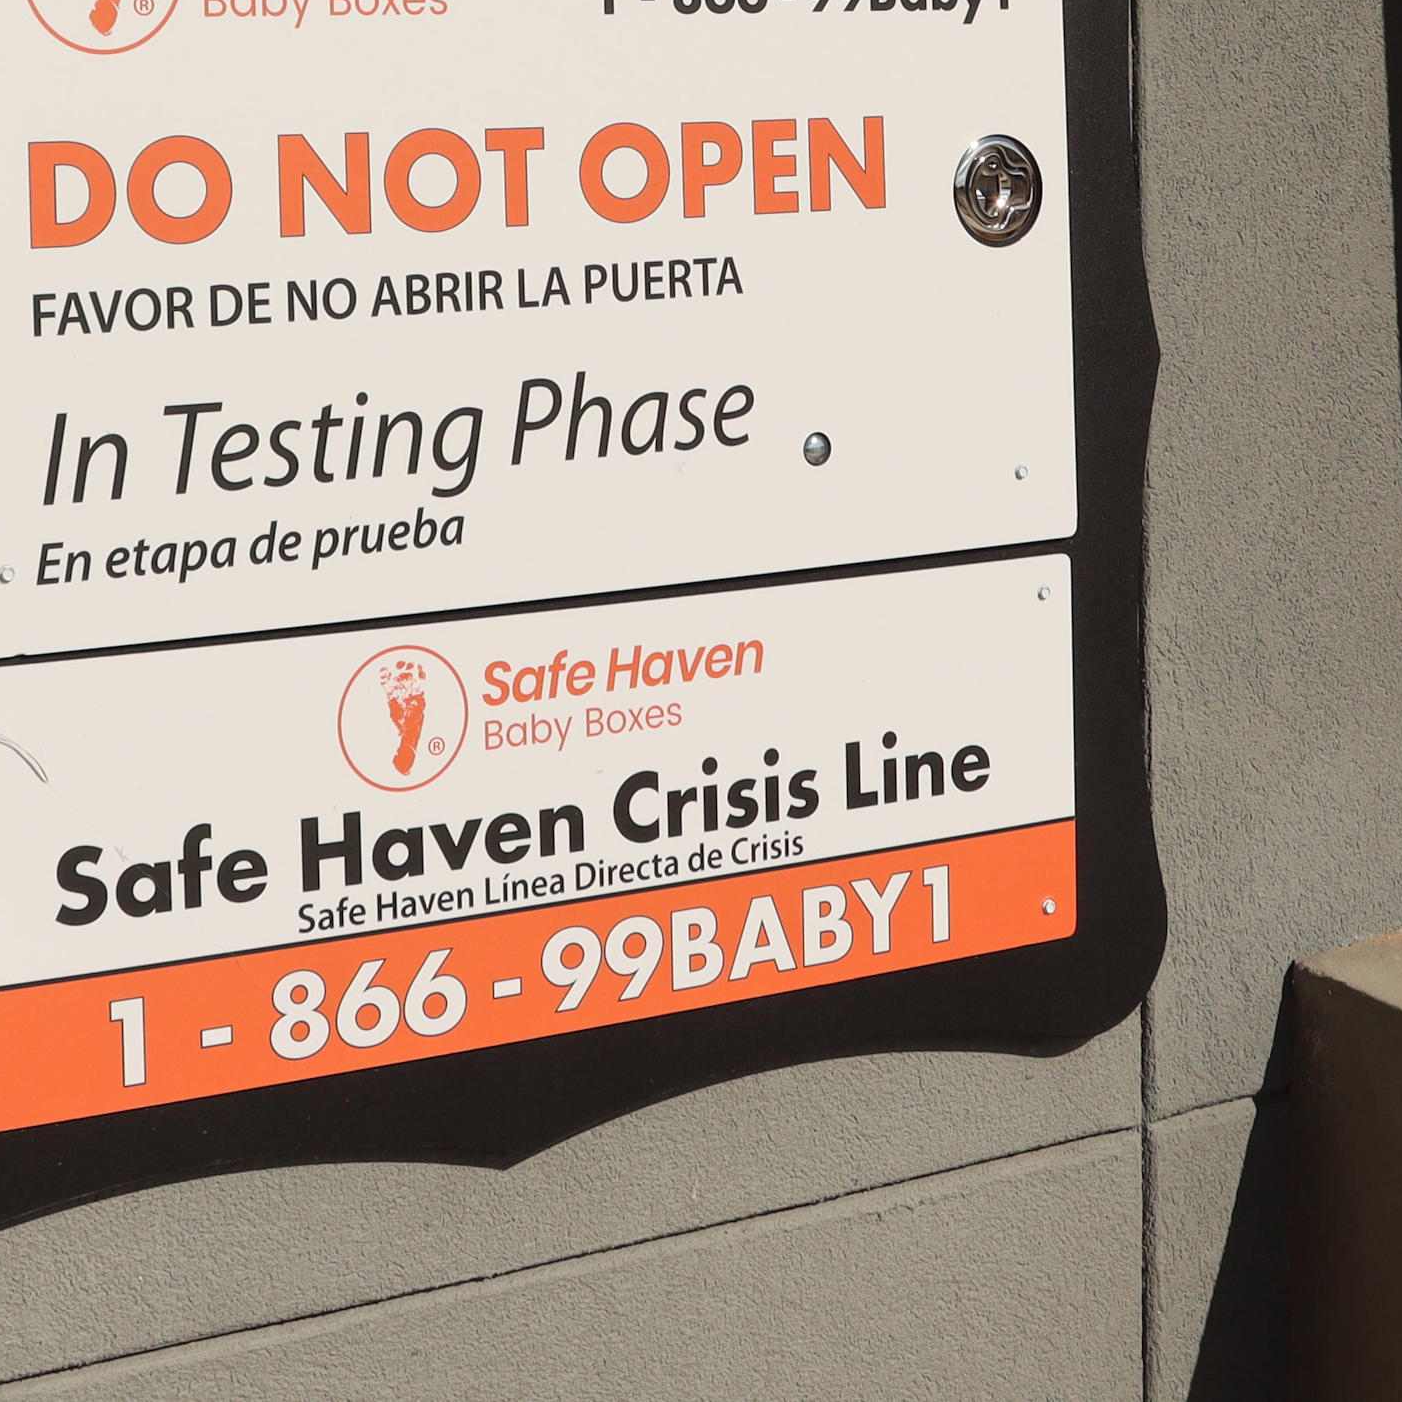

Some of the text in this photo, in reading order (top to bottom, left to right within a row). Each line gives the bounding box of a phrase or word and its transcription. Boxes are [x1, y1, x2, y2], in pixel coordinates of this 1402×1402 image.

[27, 115, 887, 250] DO NOT OPEN
[32, 256, 744, 337] FAVOR DE NO ABRIR LA PUERTA
[43, 370, 755, 506] In Testing Phase
[36, 506, 465, 586] En etapa de prueba
[482, 639, 764, 707] Safe Haven
[484, 702, 682, 752] Baby Boxes
[55, 730, 991, 927] Safe Haven Crisis Line
[298, 830, 804, 934] Safe Haven Línea Directa de Crisis
